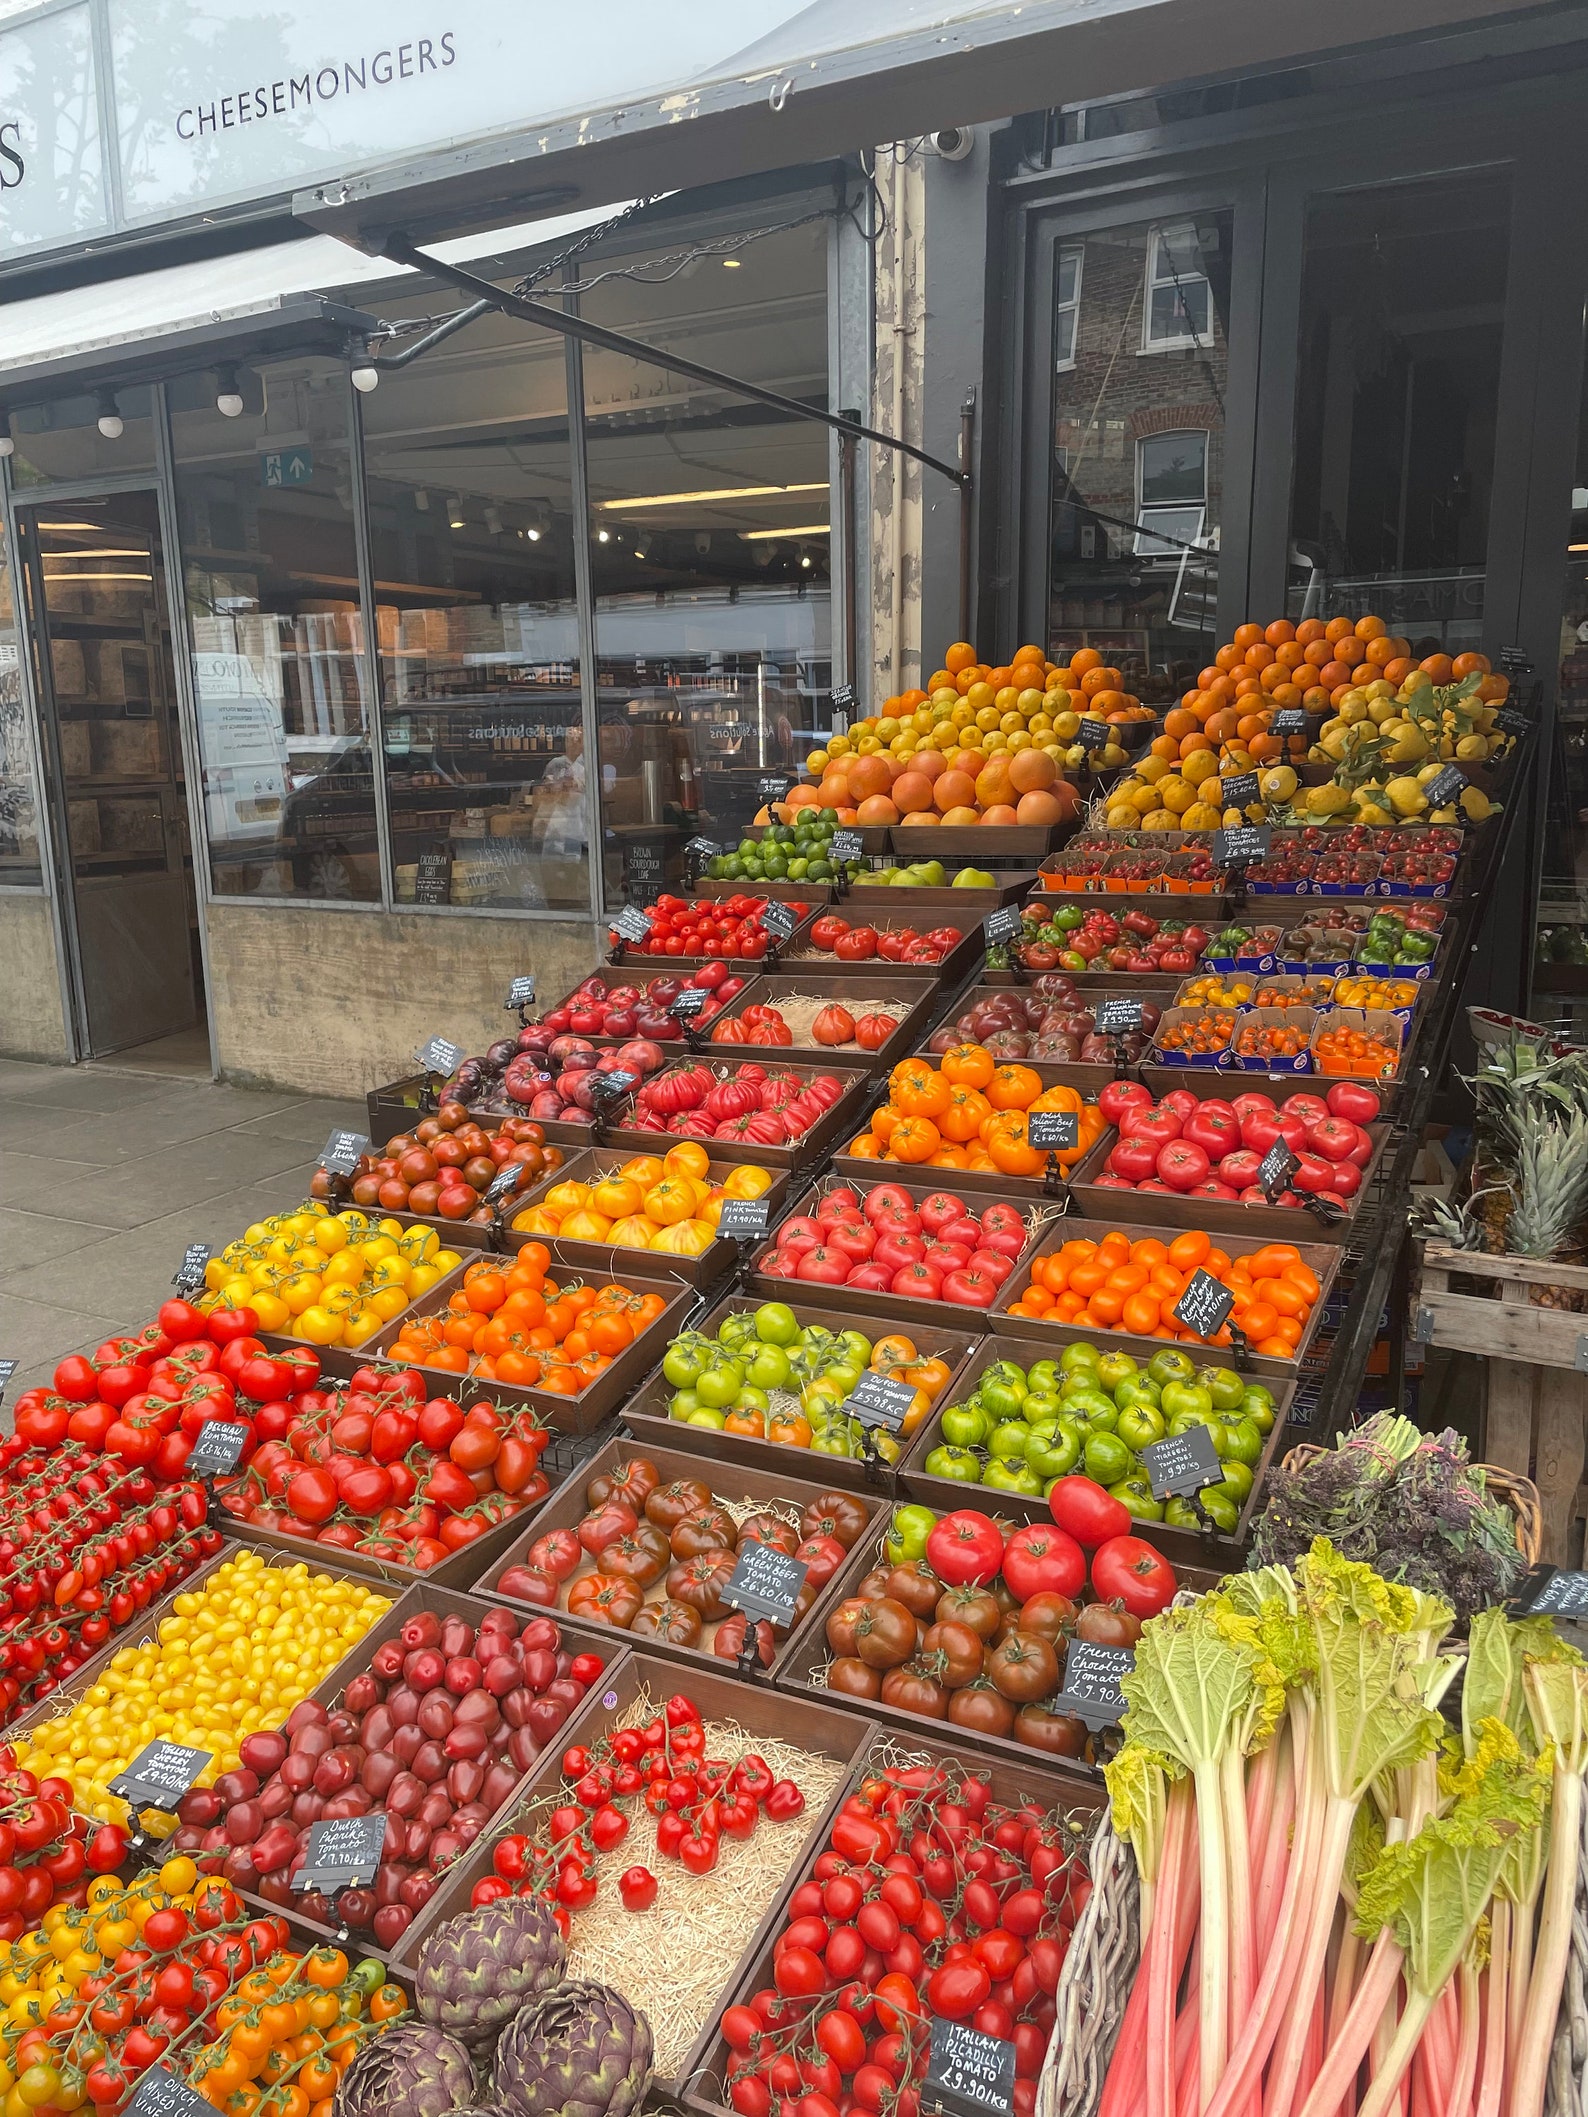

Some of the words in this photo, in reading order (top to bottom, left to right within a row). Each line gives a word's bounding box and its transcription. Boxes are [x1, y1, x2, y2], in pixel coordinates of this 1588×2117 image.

[175, 31, 457, 141] CHEESEMONGERS
[1224, 833, 1250, 842] ITALIAN
[1104, 999, 1131, 1008] FRENCH
[1030, 1117, 1055, 1127] Yellow
[1056, 1119, 1073, 1128] Beef
[206, 1421, 243, 1435] BELGIAN
[1155, 1438, 1184, 1453] FRENCH
[1158, 1451, 1193, 1469] TOMATOES
[755, 1546, 792, 1569] POLISH
[743, 1553, 773, 1571] GREEN
[772, 1568, 798, 1581] BEEF
[747, 1566, 783, 1588] TOMATO
[1078, 1643, 1131, 1662] French
[153, 1752, 190, 1767] CHERRY
[160, 1744, 197, 1758] YELLOW
[147, 1759, 191, 1777] TOMATOES
[330, 1818, 364, 1833] Dutch
[318, 1830, 368, 1845] Paprika
[318, 1839, 366, 1854] Tomato
[944, 2039, 1005, 2074] PICADILLY
[949, 2054, 997, 2082] TOMATO
[143, 2081, 175, 2109] MIXED
[165, 2078, 199, 2107] DUTCH
